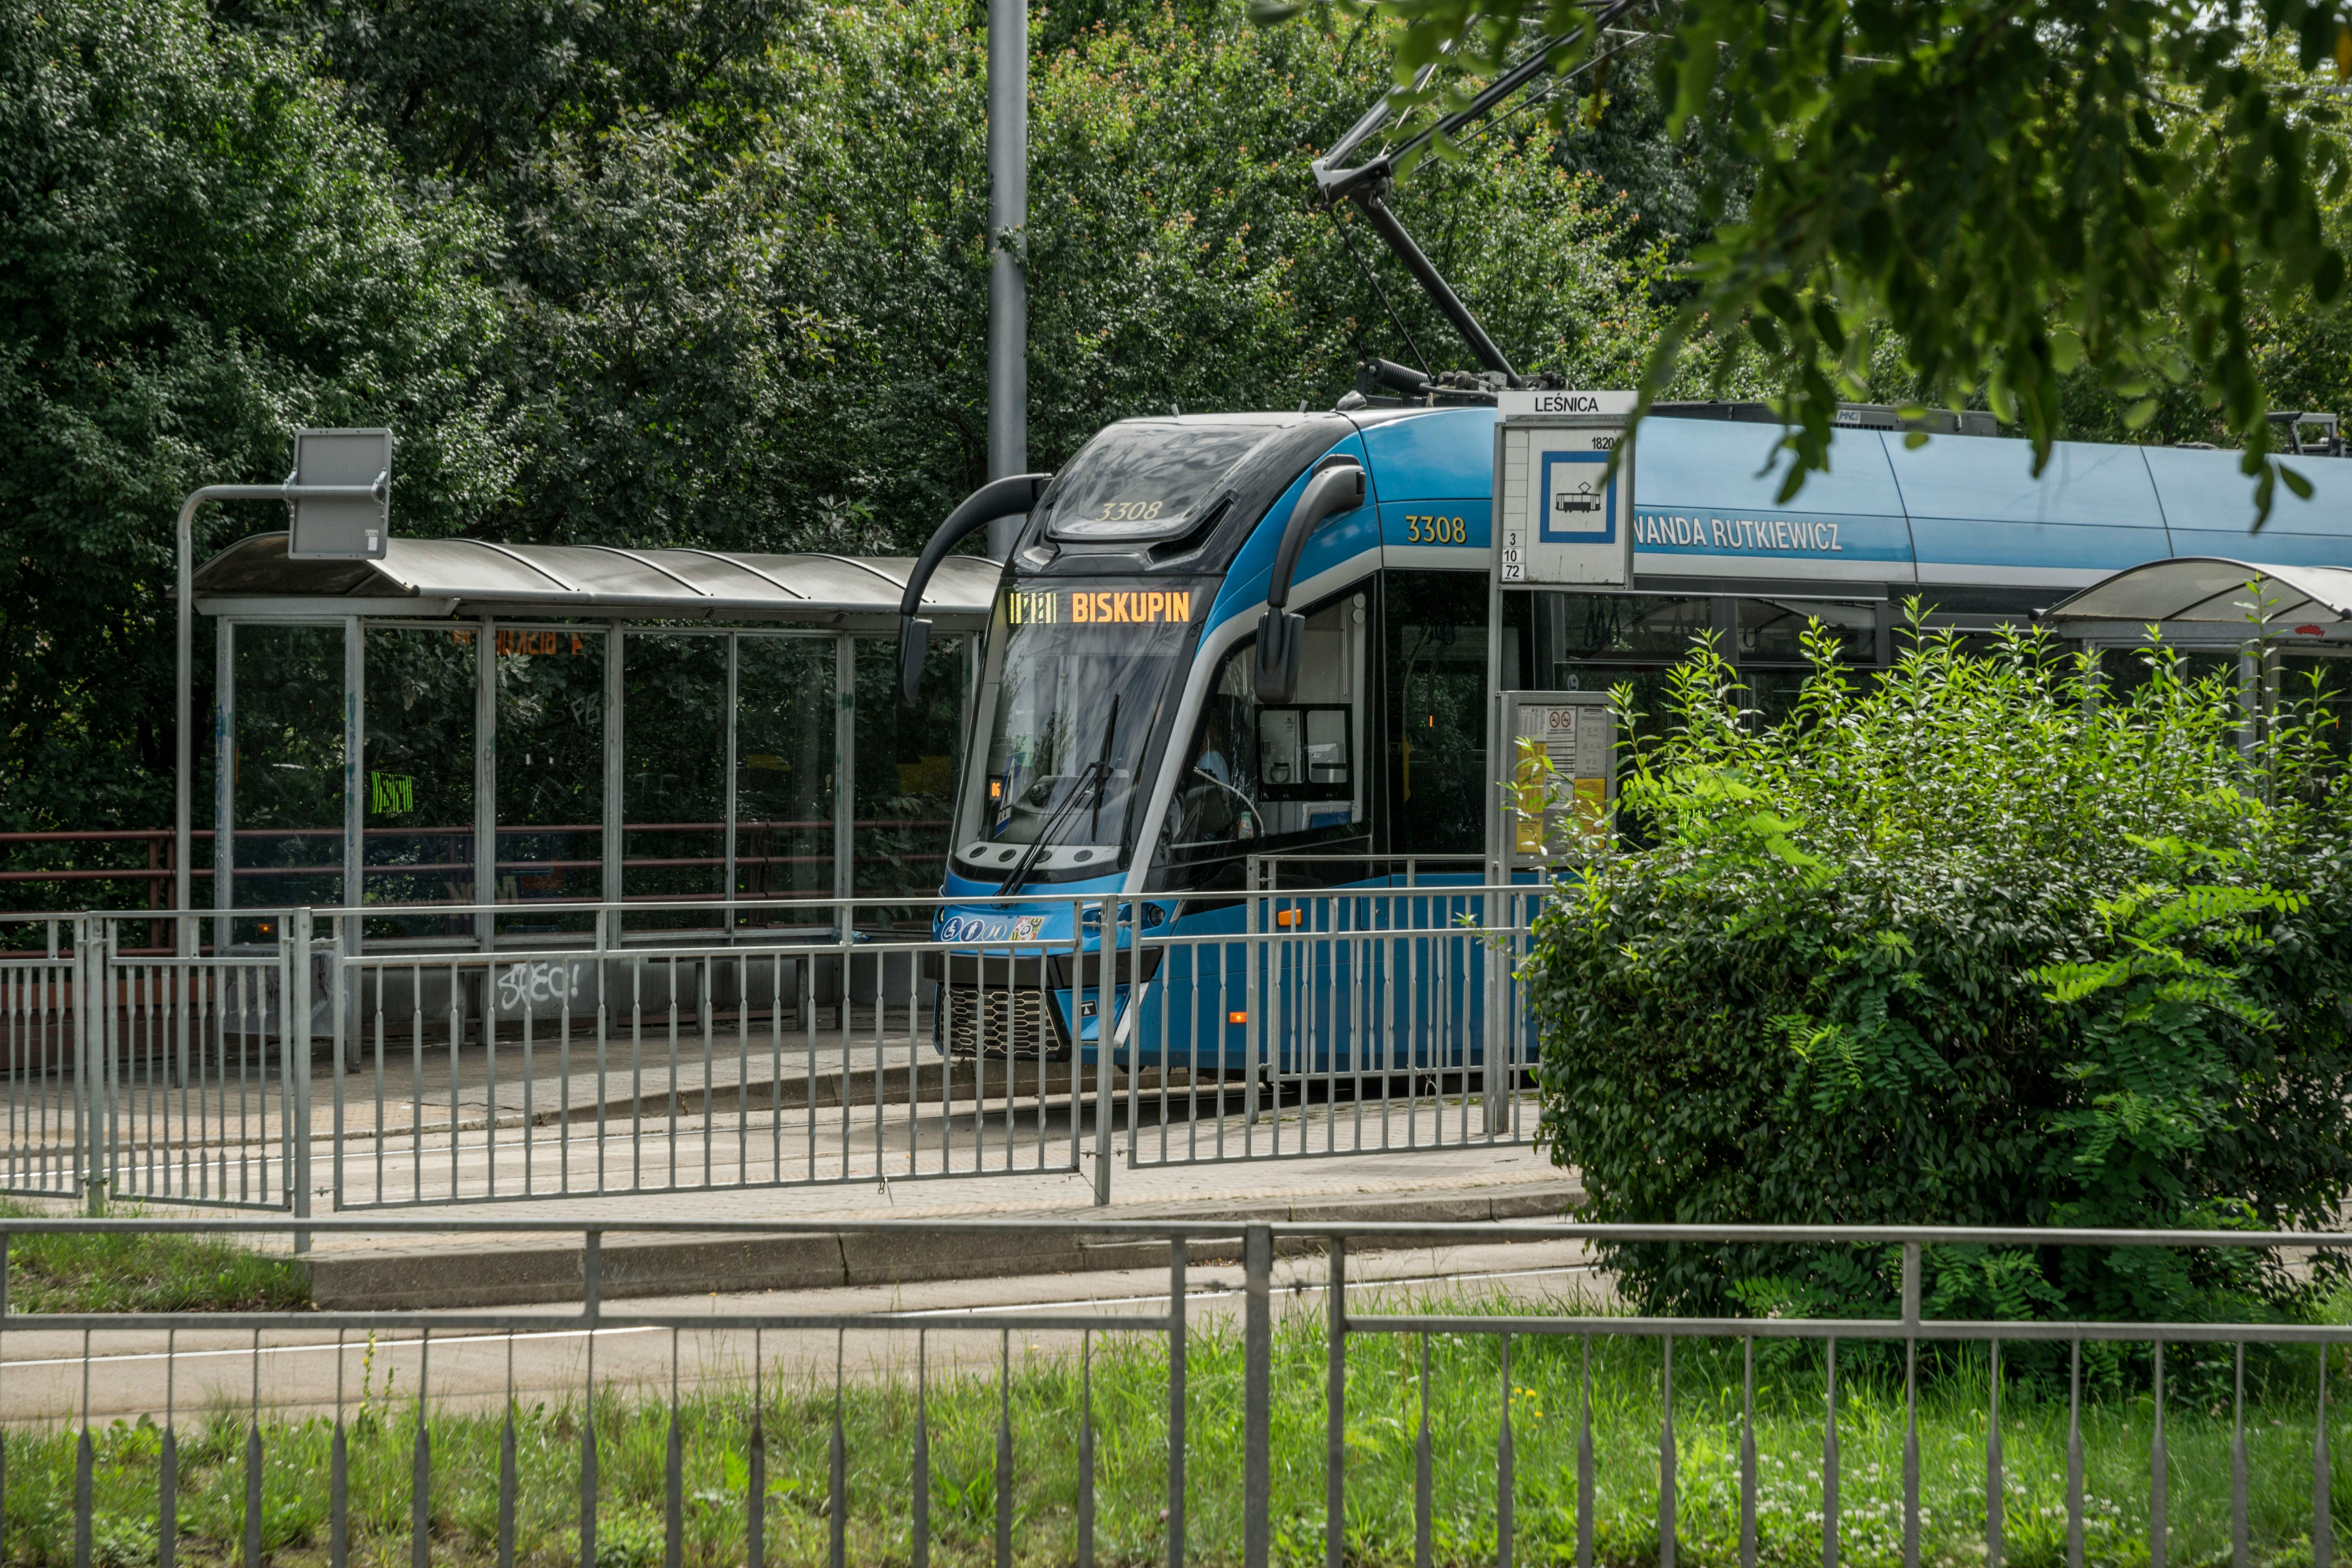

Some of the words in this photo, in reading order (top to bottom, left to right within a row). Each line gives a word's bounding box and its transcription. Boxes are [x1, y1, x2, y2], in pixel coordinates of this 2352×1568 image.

[1535, 392, 1599, 412] LEŚNICA
[1095, 501, 1163, 521] 3308
[1405, 515, 1467, 544] 3308
[1510, 533, 1516, 546] 3
[1711, 518, 1842, 552] RUTKIEWICZ
[1504, 550, 1517, 562] 10
[1506, 565, 1519, 577] 72
[1073, 592, 1189, 622] BISKUPIN
